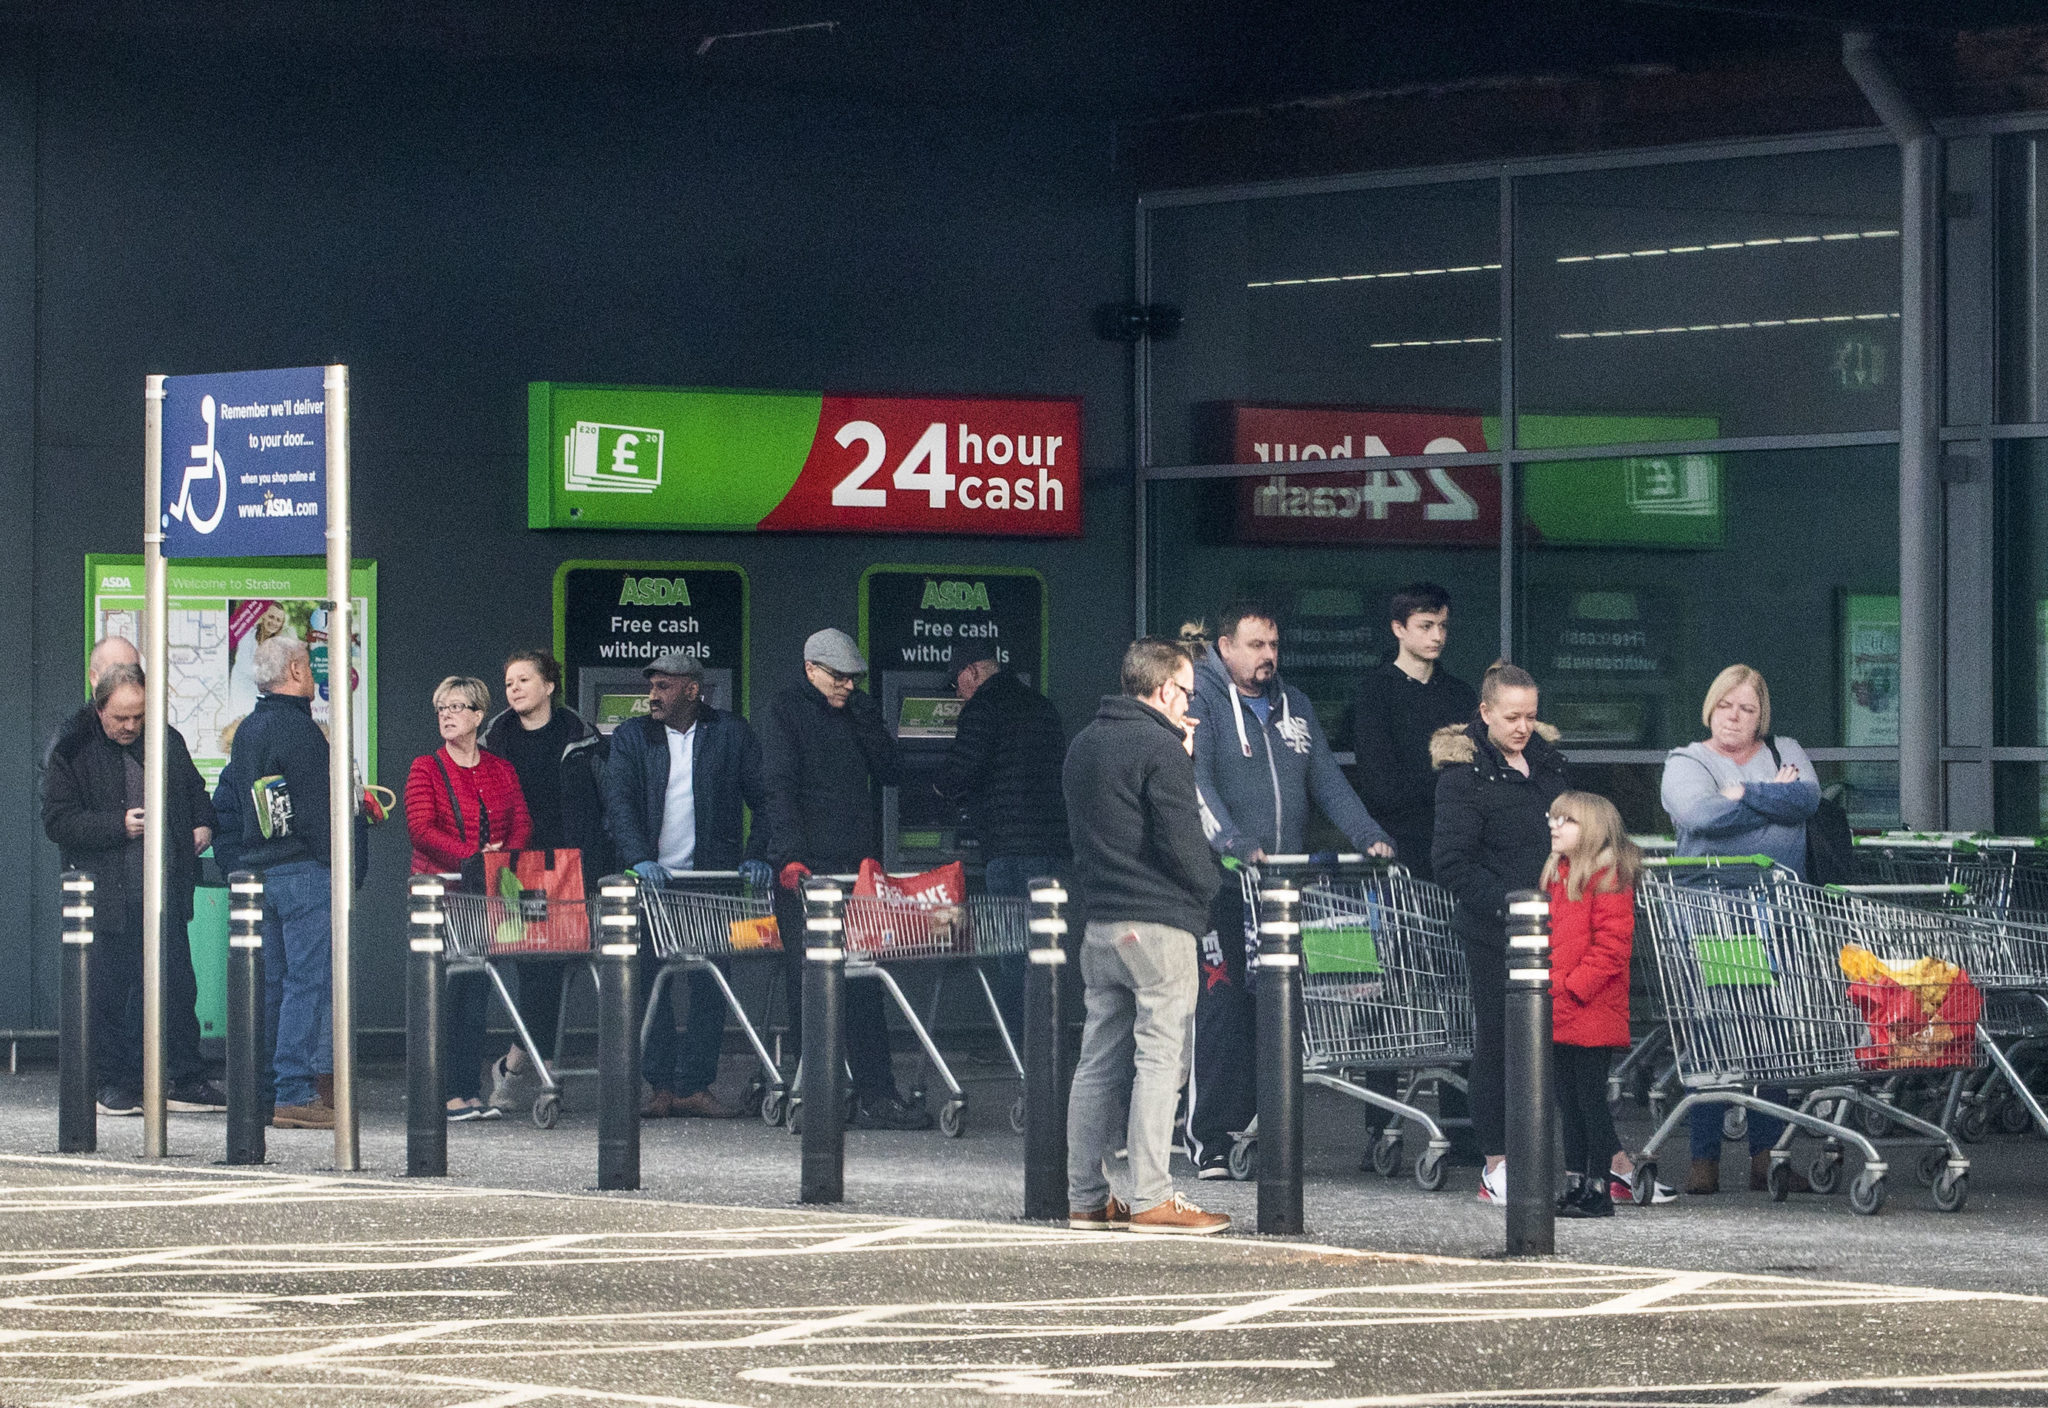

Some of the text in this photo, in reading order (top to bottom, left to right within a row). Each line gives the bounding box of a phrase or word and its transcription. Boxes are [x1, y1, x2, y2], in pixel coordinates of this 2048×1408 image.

[221, 399, 324, 419] Remember we'll deliver
[580, 426, 597, 434] £20
[645, 435, 658, 443] 20
[249, 433, 258, 448] to
[260, 435, 281, 452] your
[959, 424, 1062, 466] hour
[611, 433, 640, 474] £
[832, 420, 955, 508] 24
[240, 470, 316, 486] when you shop online at
[958, 468, 1064, 511] cash
[101, 577, 132, 588] ASDA
[173, 578, 290, 591] Welcome to Straiton
[619, 577, 691, 606] ASDA
[921, 581, 990, 610] ASDA
[611, 616, 699, 633] Free cash
[913, 620, 999, 638] Free cash
[600, 641, 711, 658] withdrawals
[902, 645, 1010, 663] withdls
[631, 698, 650, 713] AS
[932, 702, 961, 717] ASD
